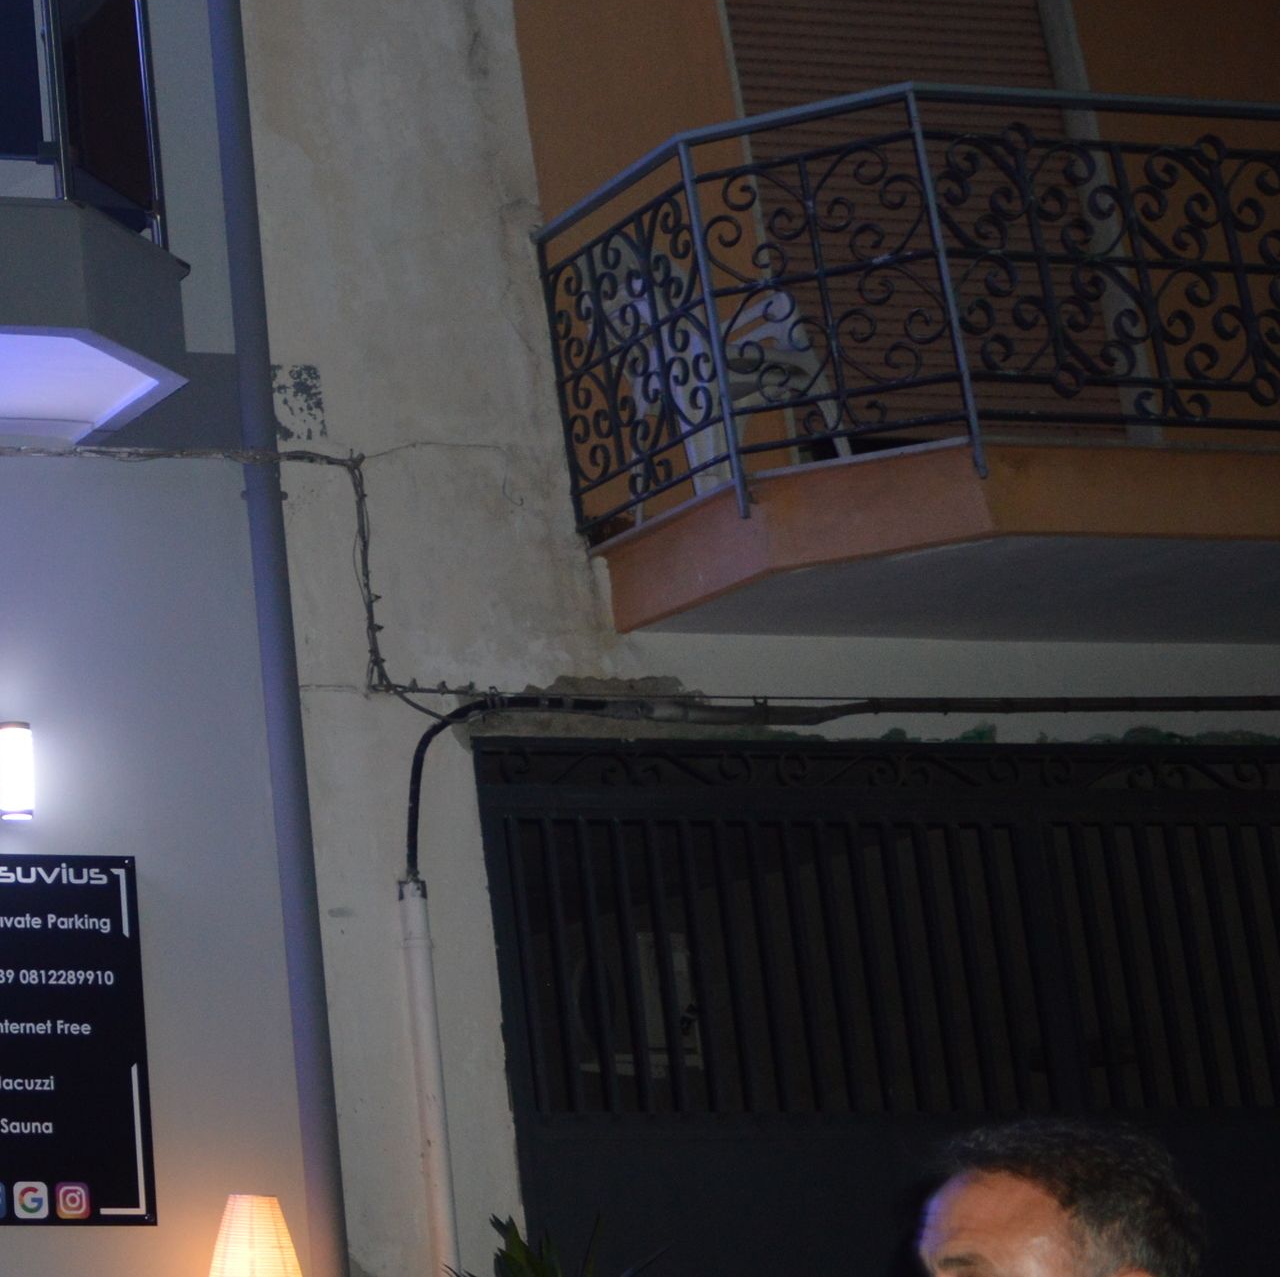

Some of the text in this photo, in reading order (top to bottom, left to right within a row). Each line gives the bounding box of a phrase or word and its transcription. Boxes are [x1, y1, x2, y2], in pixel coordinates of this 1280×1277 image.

[47, 913, 111, 934] Parking
[19, 969, 115, 986] 0812289910
[56, 1019, 92, 1035] Free
[0, 1118, 53, 1134] Sauna
